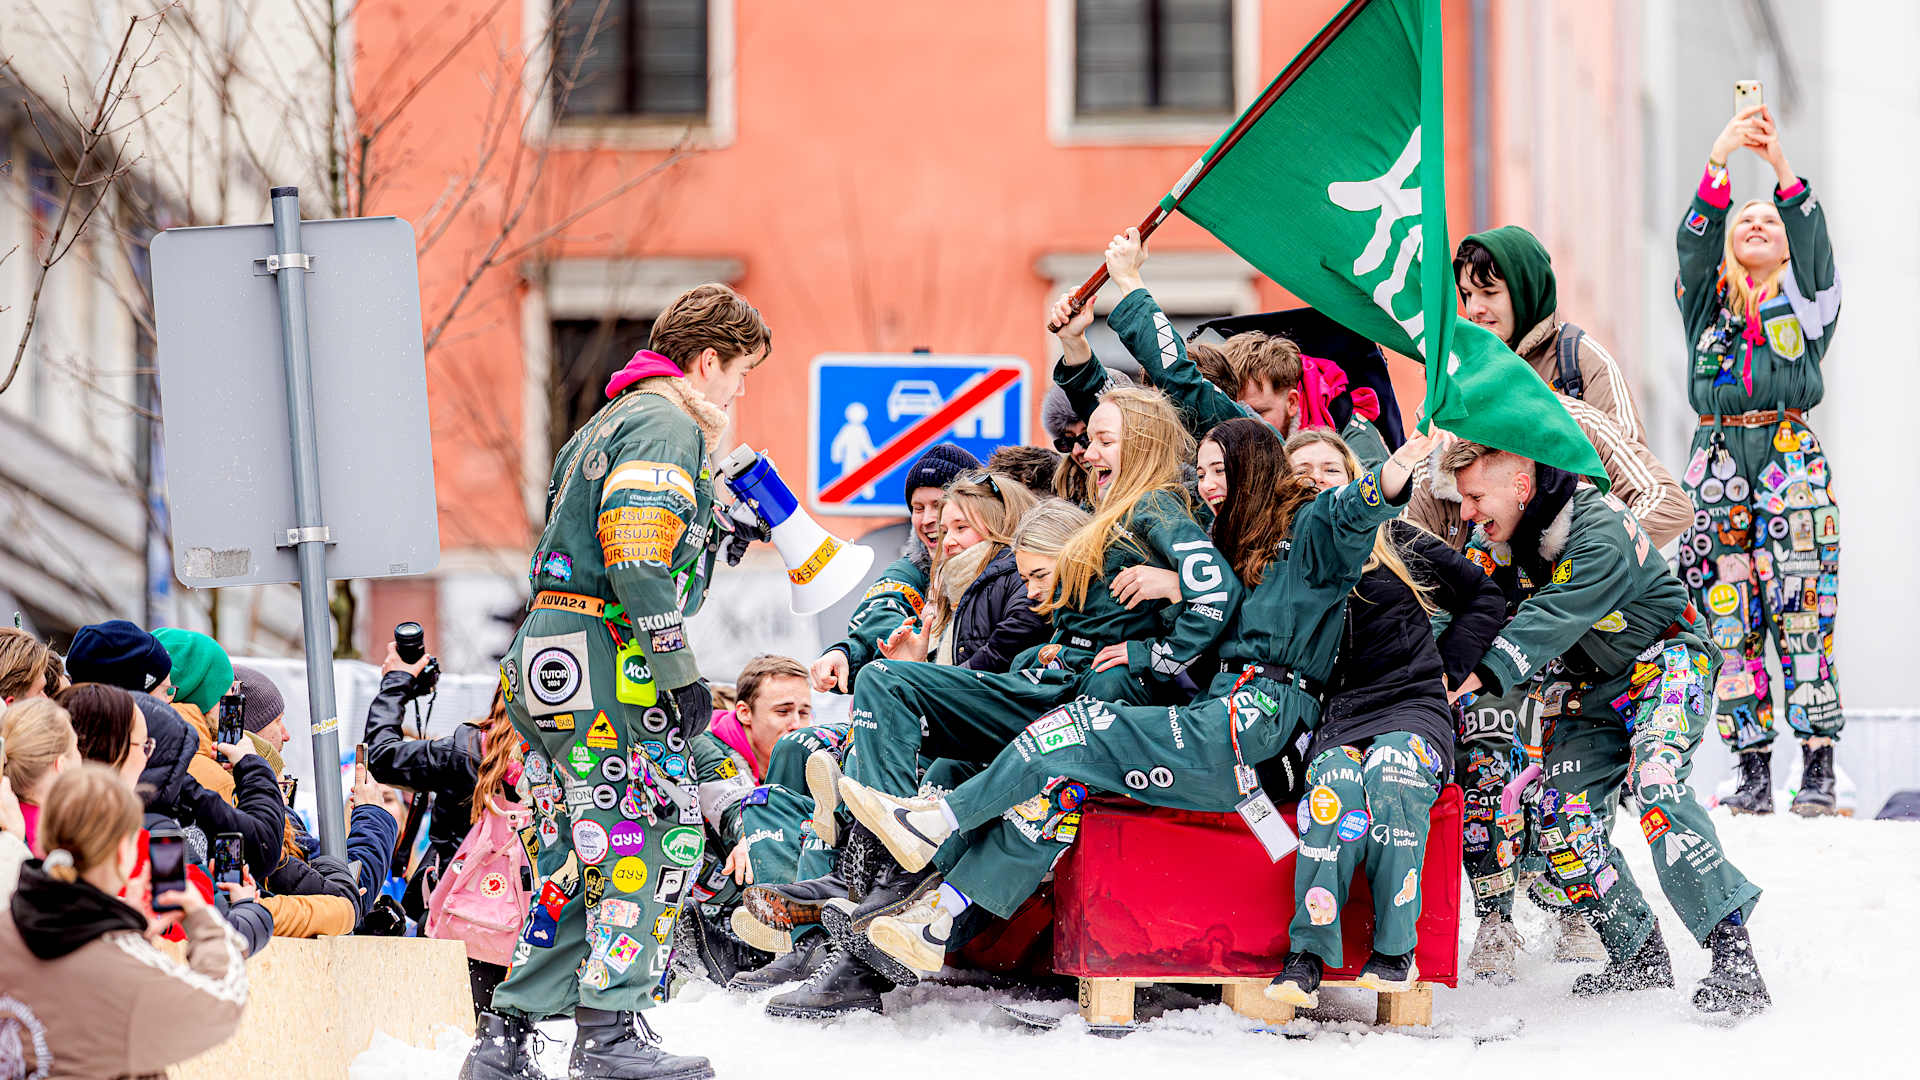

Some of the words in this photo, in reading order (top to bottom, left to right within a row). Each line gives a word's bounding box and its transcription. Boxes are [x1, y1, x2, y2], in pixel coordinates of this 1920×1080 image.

[541, 594, 587, 610] KUVA24
[1190, 603, 1224, 622] DIESEL
[541, 669, 568, 680] TUTOR
[1464, 707, 1516, 736] BDO
[611, 832, 643, 847] ayy
[616, 869, 644, 881] ayy
